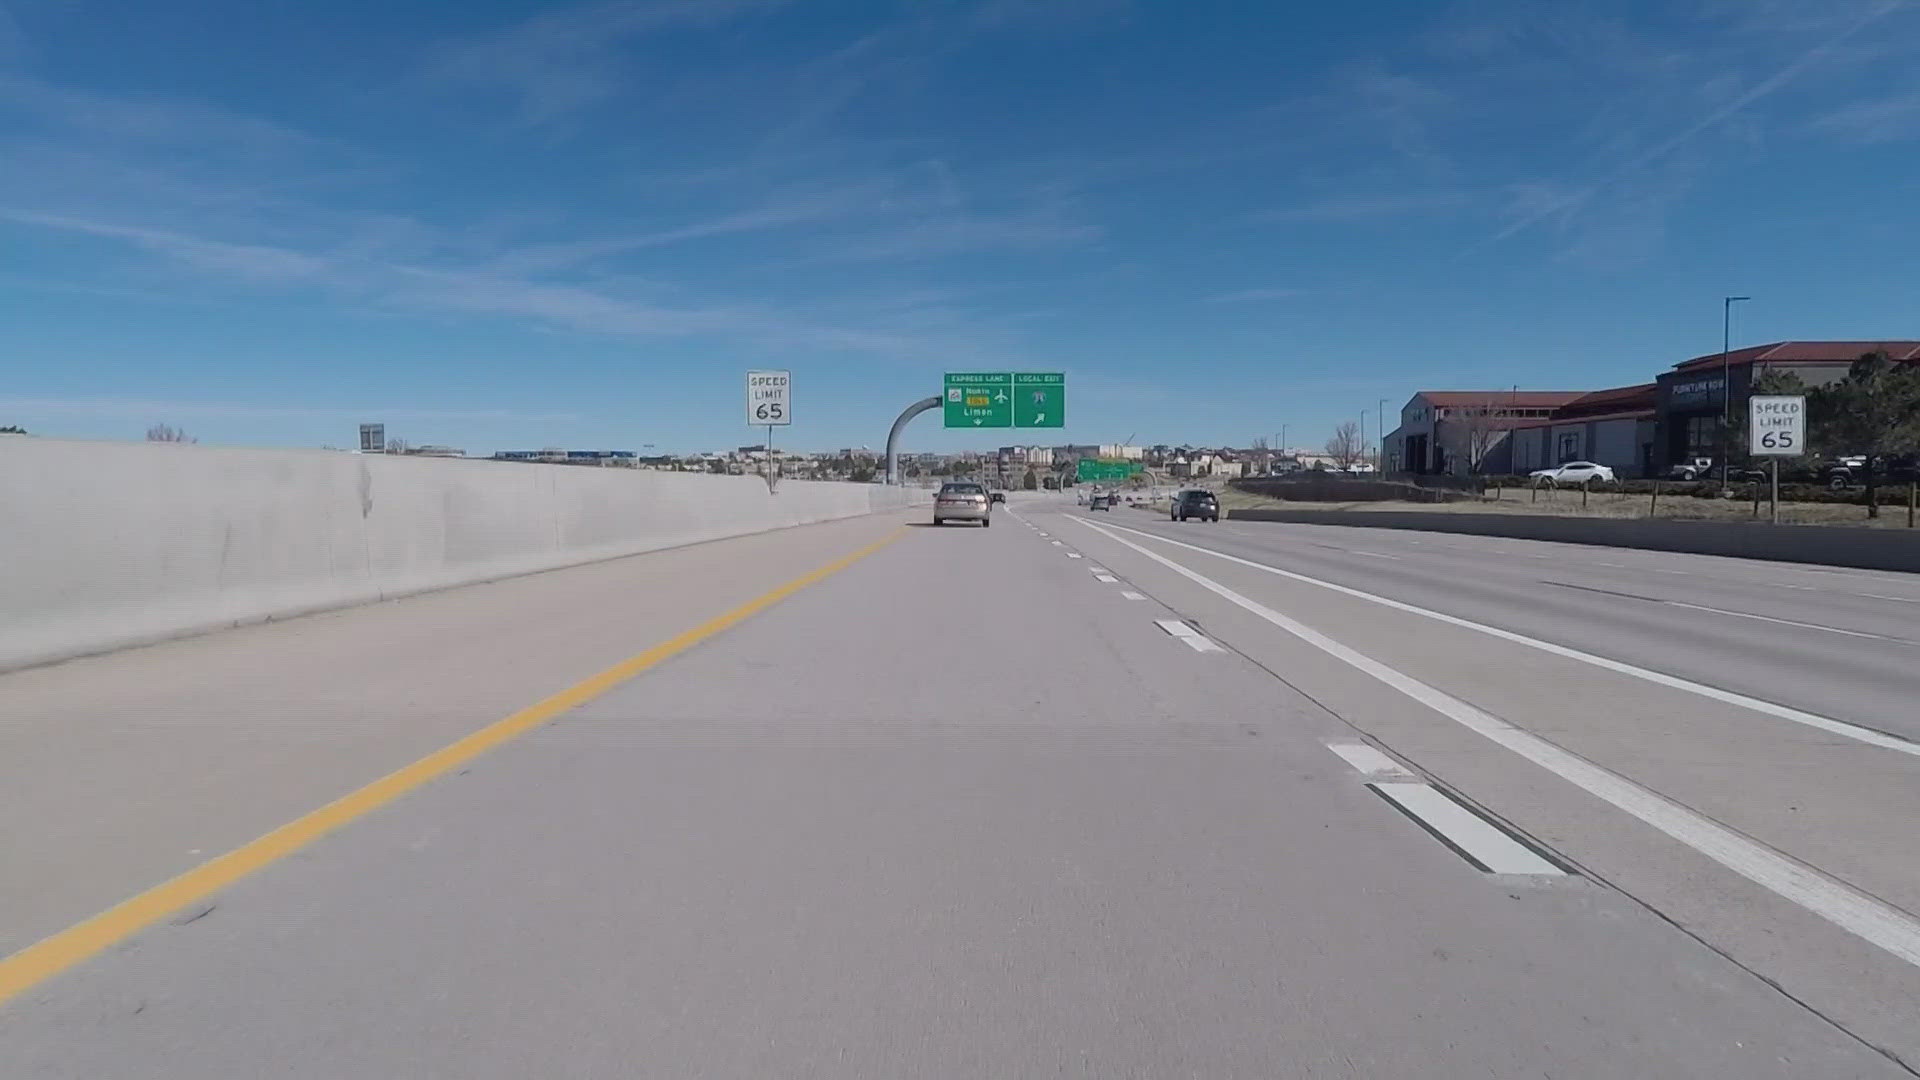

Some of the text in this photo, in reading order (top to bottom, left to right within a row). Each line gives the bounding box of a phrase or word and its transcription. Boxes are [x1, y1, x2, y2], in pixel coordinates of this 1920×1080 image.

[751, 377, 787, 386] SPEED
[755, 390, 782, 400] LIMIT
[756, 403, 782, 420] 65
[963, 408, 993, 416] Limon
[1756, 403, 1800, 414] SPEED
[1760, 417, 1794, 426] LIMIT
[1761, 431, 1793, 448] 65
